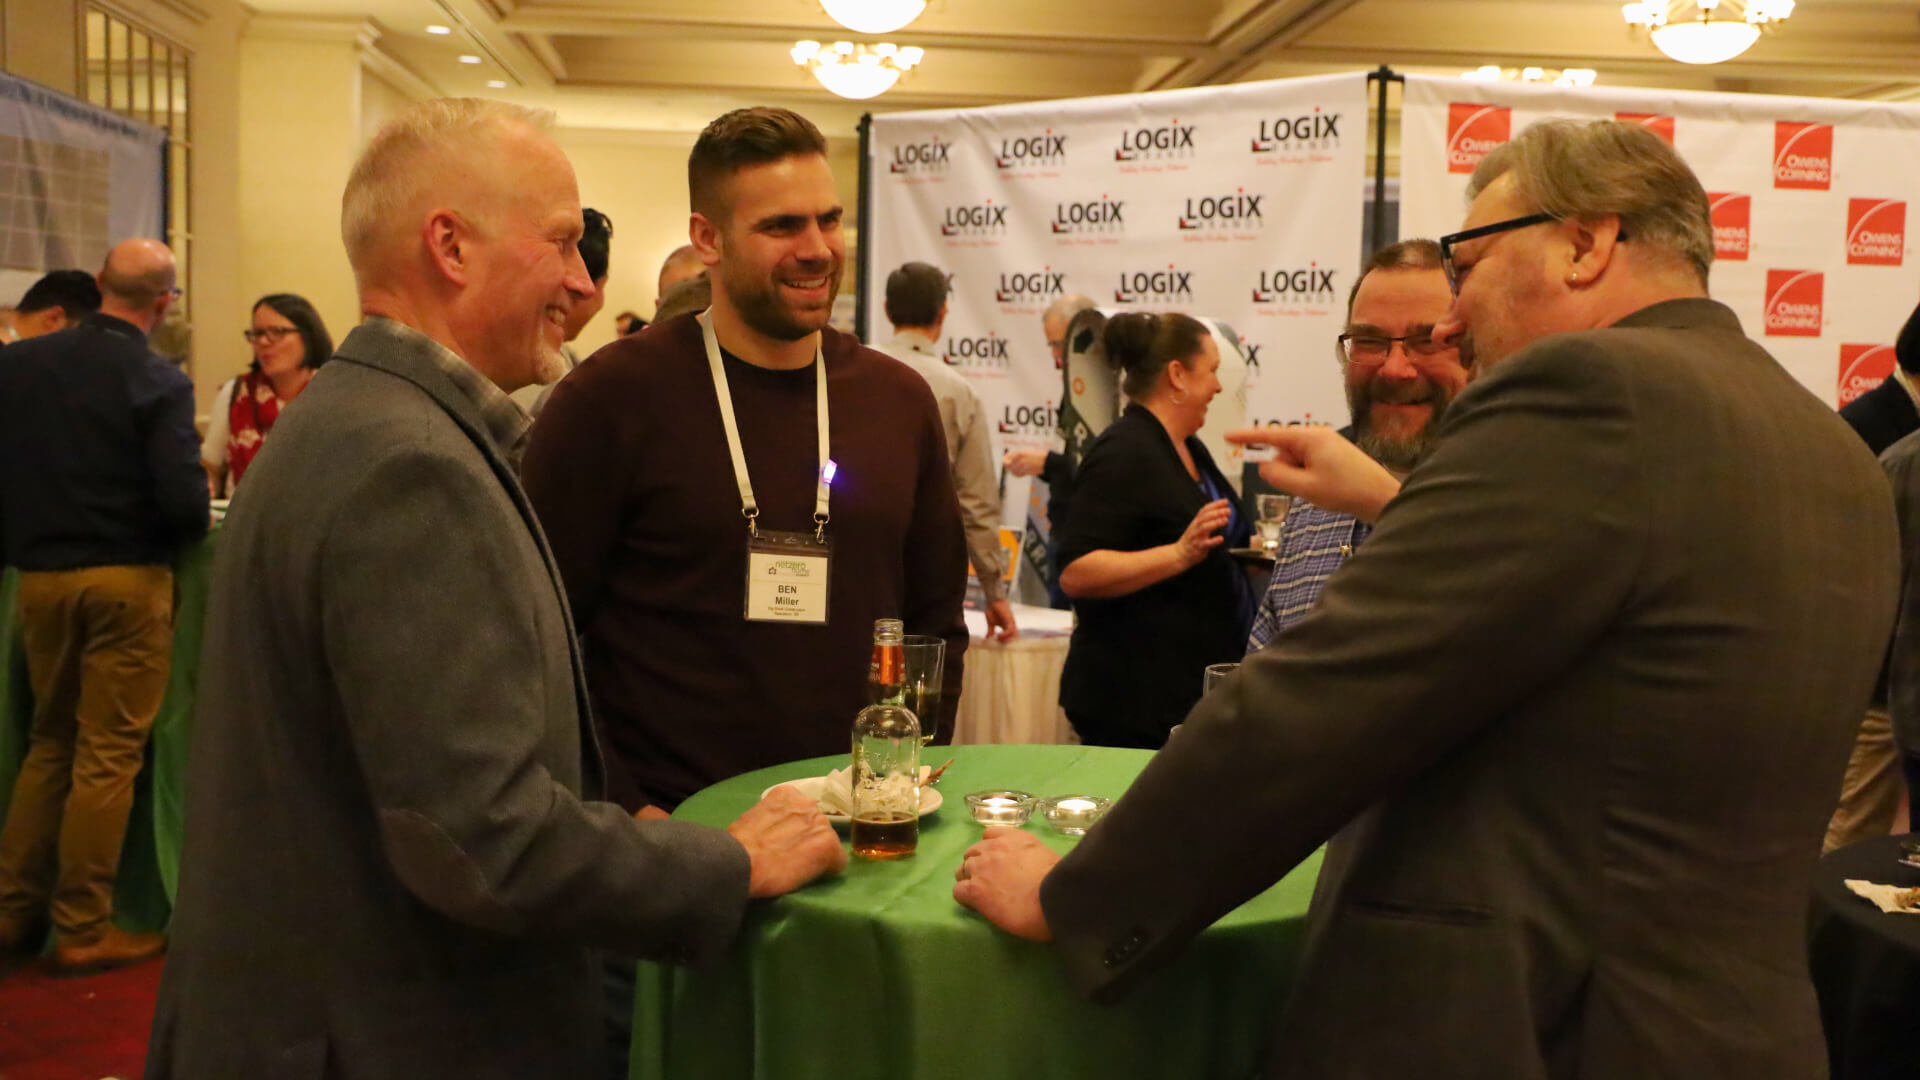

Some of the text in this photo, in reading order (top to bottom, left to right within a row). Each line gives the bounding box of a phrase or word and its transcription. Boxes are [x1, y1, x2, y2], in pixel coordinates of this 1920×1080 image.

[1122, 118, 1194, 152] LOGIX
[1260, 107, 1339, 142] LOGIX
[894, 136, 951, 165] LOGIX
[1002, 128, 1066, 159] LOGIX
[946, 198, 1007, 227] LOGIX
[1058, 193, 1123, 224] LOGIX
[1187, 187, 1262, 219] LOGIX
[1001, 265, 1064, 294] LOGIX
[1121, 263, 1192, 294] LOGIX
[1260, 261, 1334, 293] LOGIX
[948, 330, 1008, 359] LOGIX
[775, 596, 799, 606] Miller
[778, 585, 797, 594] BEN
